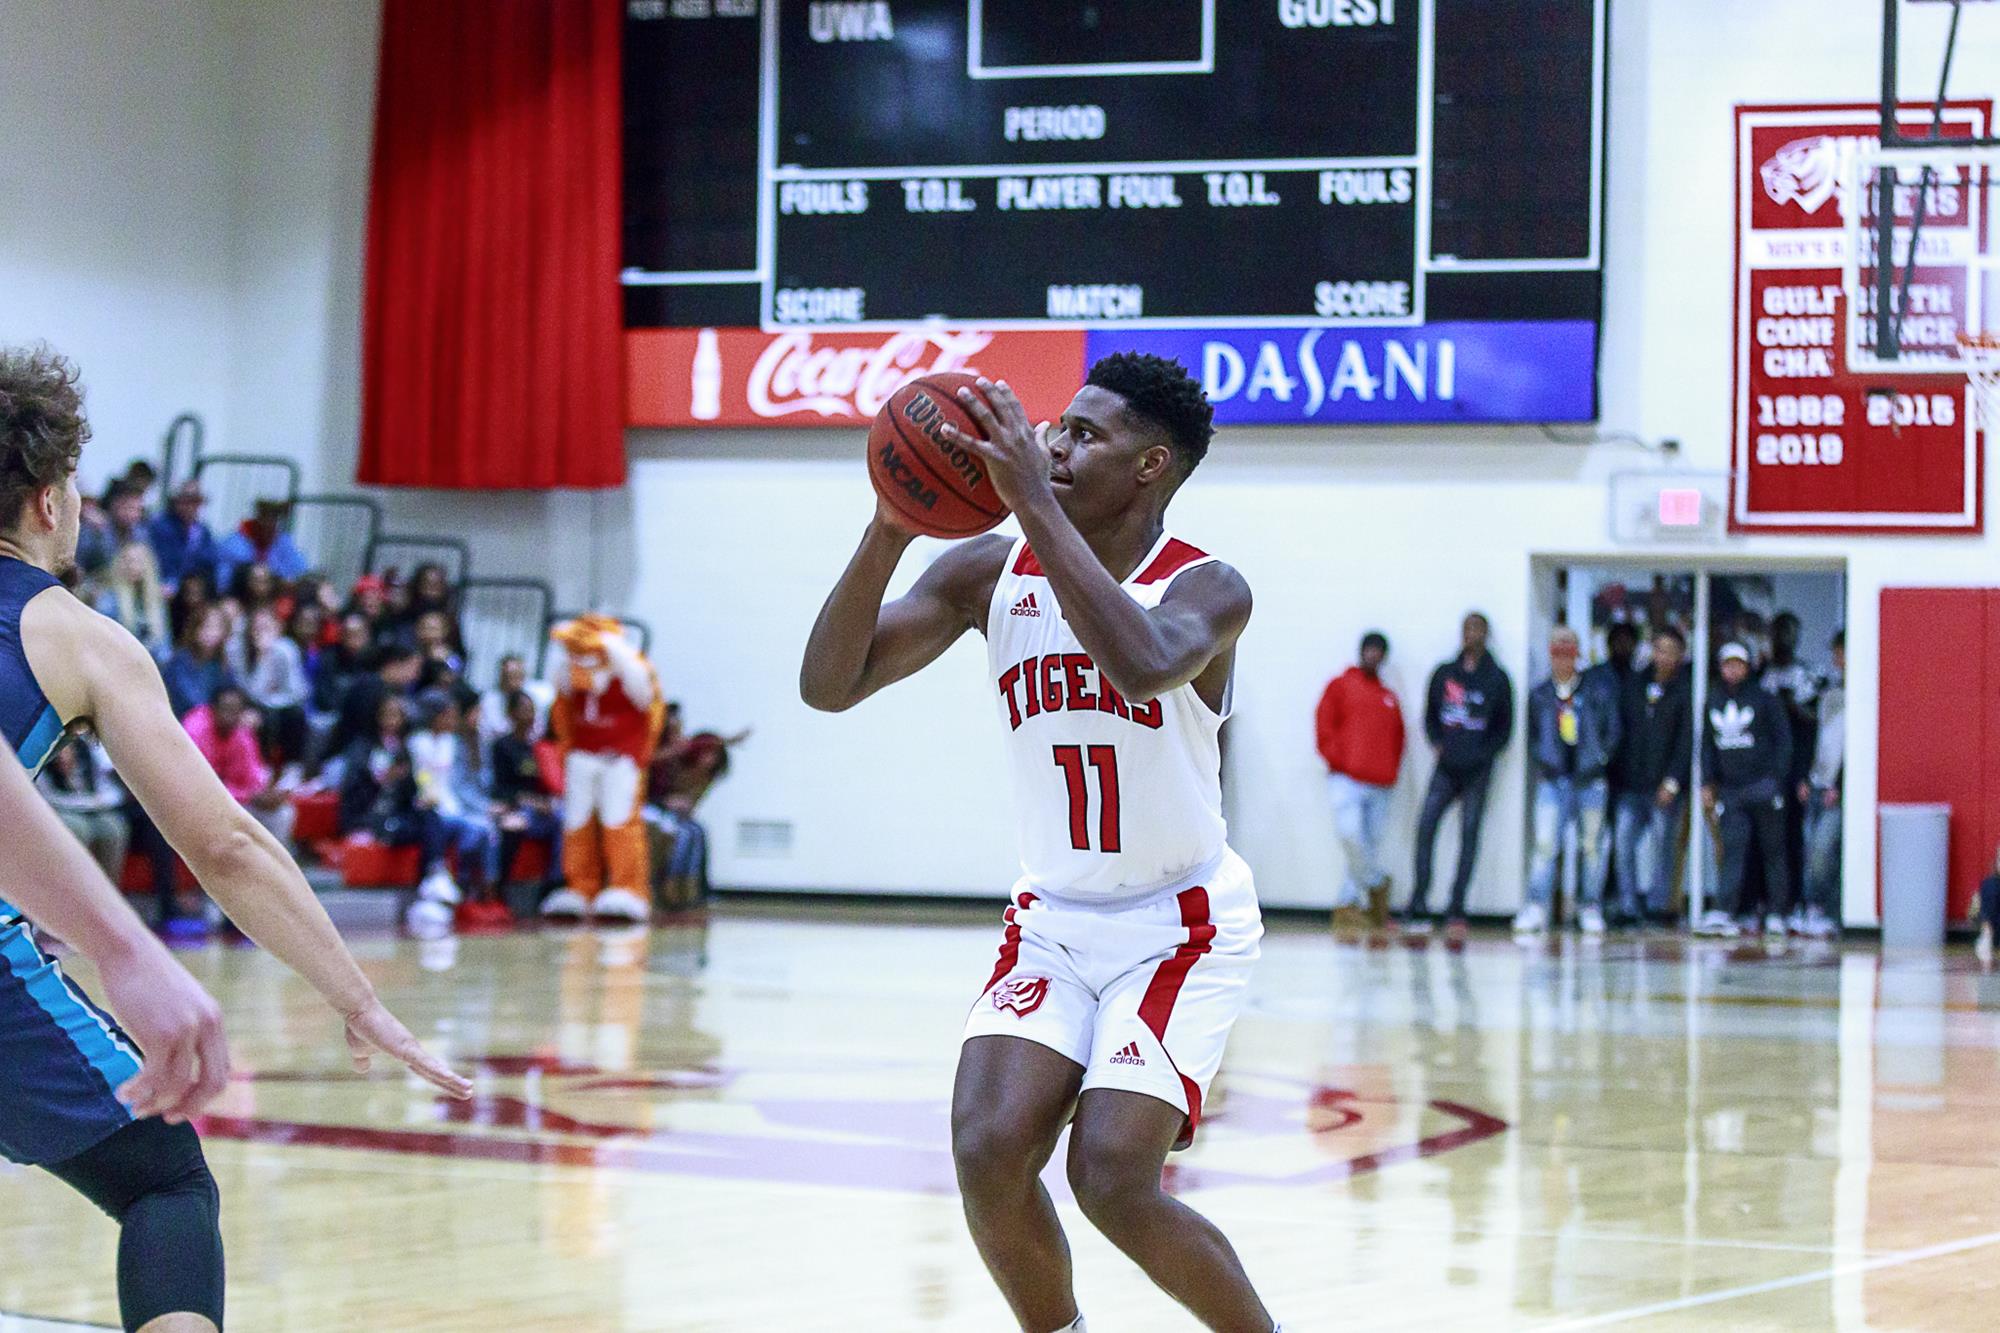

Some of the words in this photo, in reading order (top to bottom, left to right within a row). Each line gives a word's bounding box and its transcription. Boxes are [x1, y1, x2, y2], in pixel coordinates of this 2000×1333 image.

[809, 2, 894, 43] UWA
[1277, 0, 1395, 28] GUEST
[1004, 106, 1106, 141] PERIOD
[780, 180, 868, 215] FOULS
[997, 176, 1099, 210] PLAYER
[1109, 175, 1182, 208] FOUL
[1319, 169, 1412, 204] FOULS
[775, 288, 866, 324] SCORE
[1046, 284, 1143, 319] MATCH
[1314, 281, 1410, 317] SCORE
[1763, 285, 1842, 315] GULF
[1203, 329, 1456, 416] DASANI
[880, 441, 940, 511] NCAA
[1010, 607, 1040, 617] adidas
[1052, 744, 1121, 853] 11
[1109, 1056, 1145, 1066] adidas
